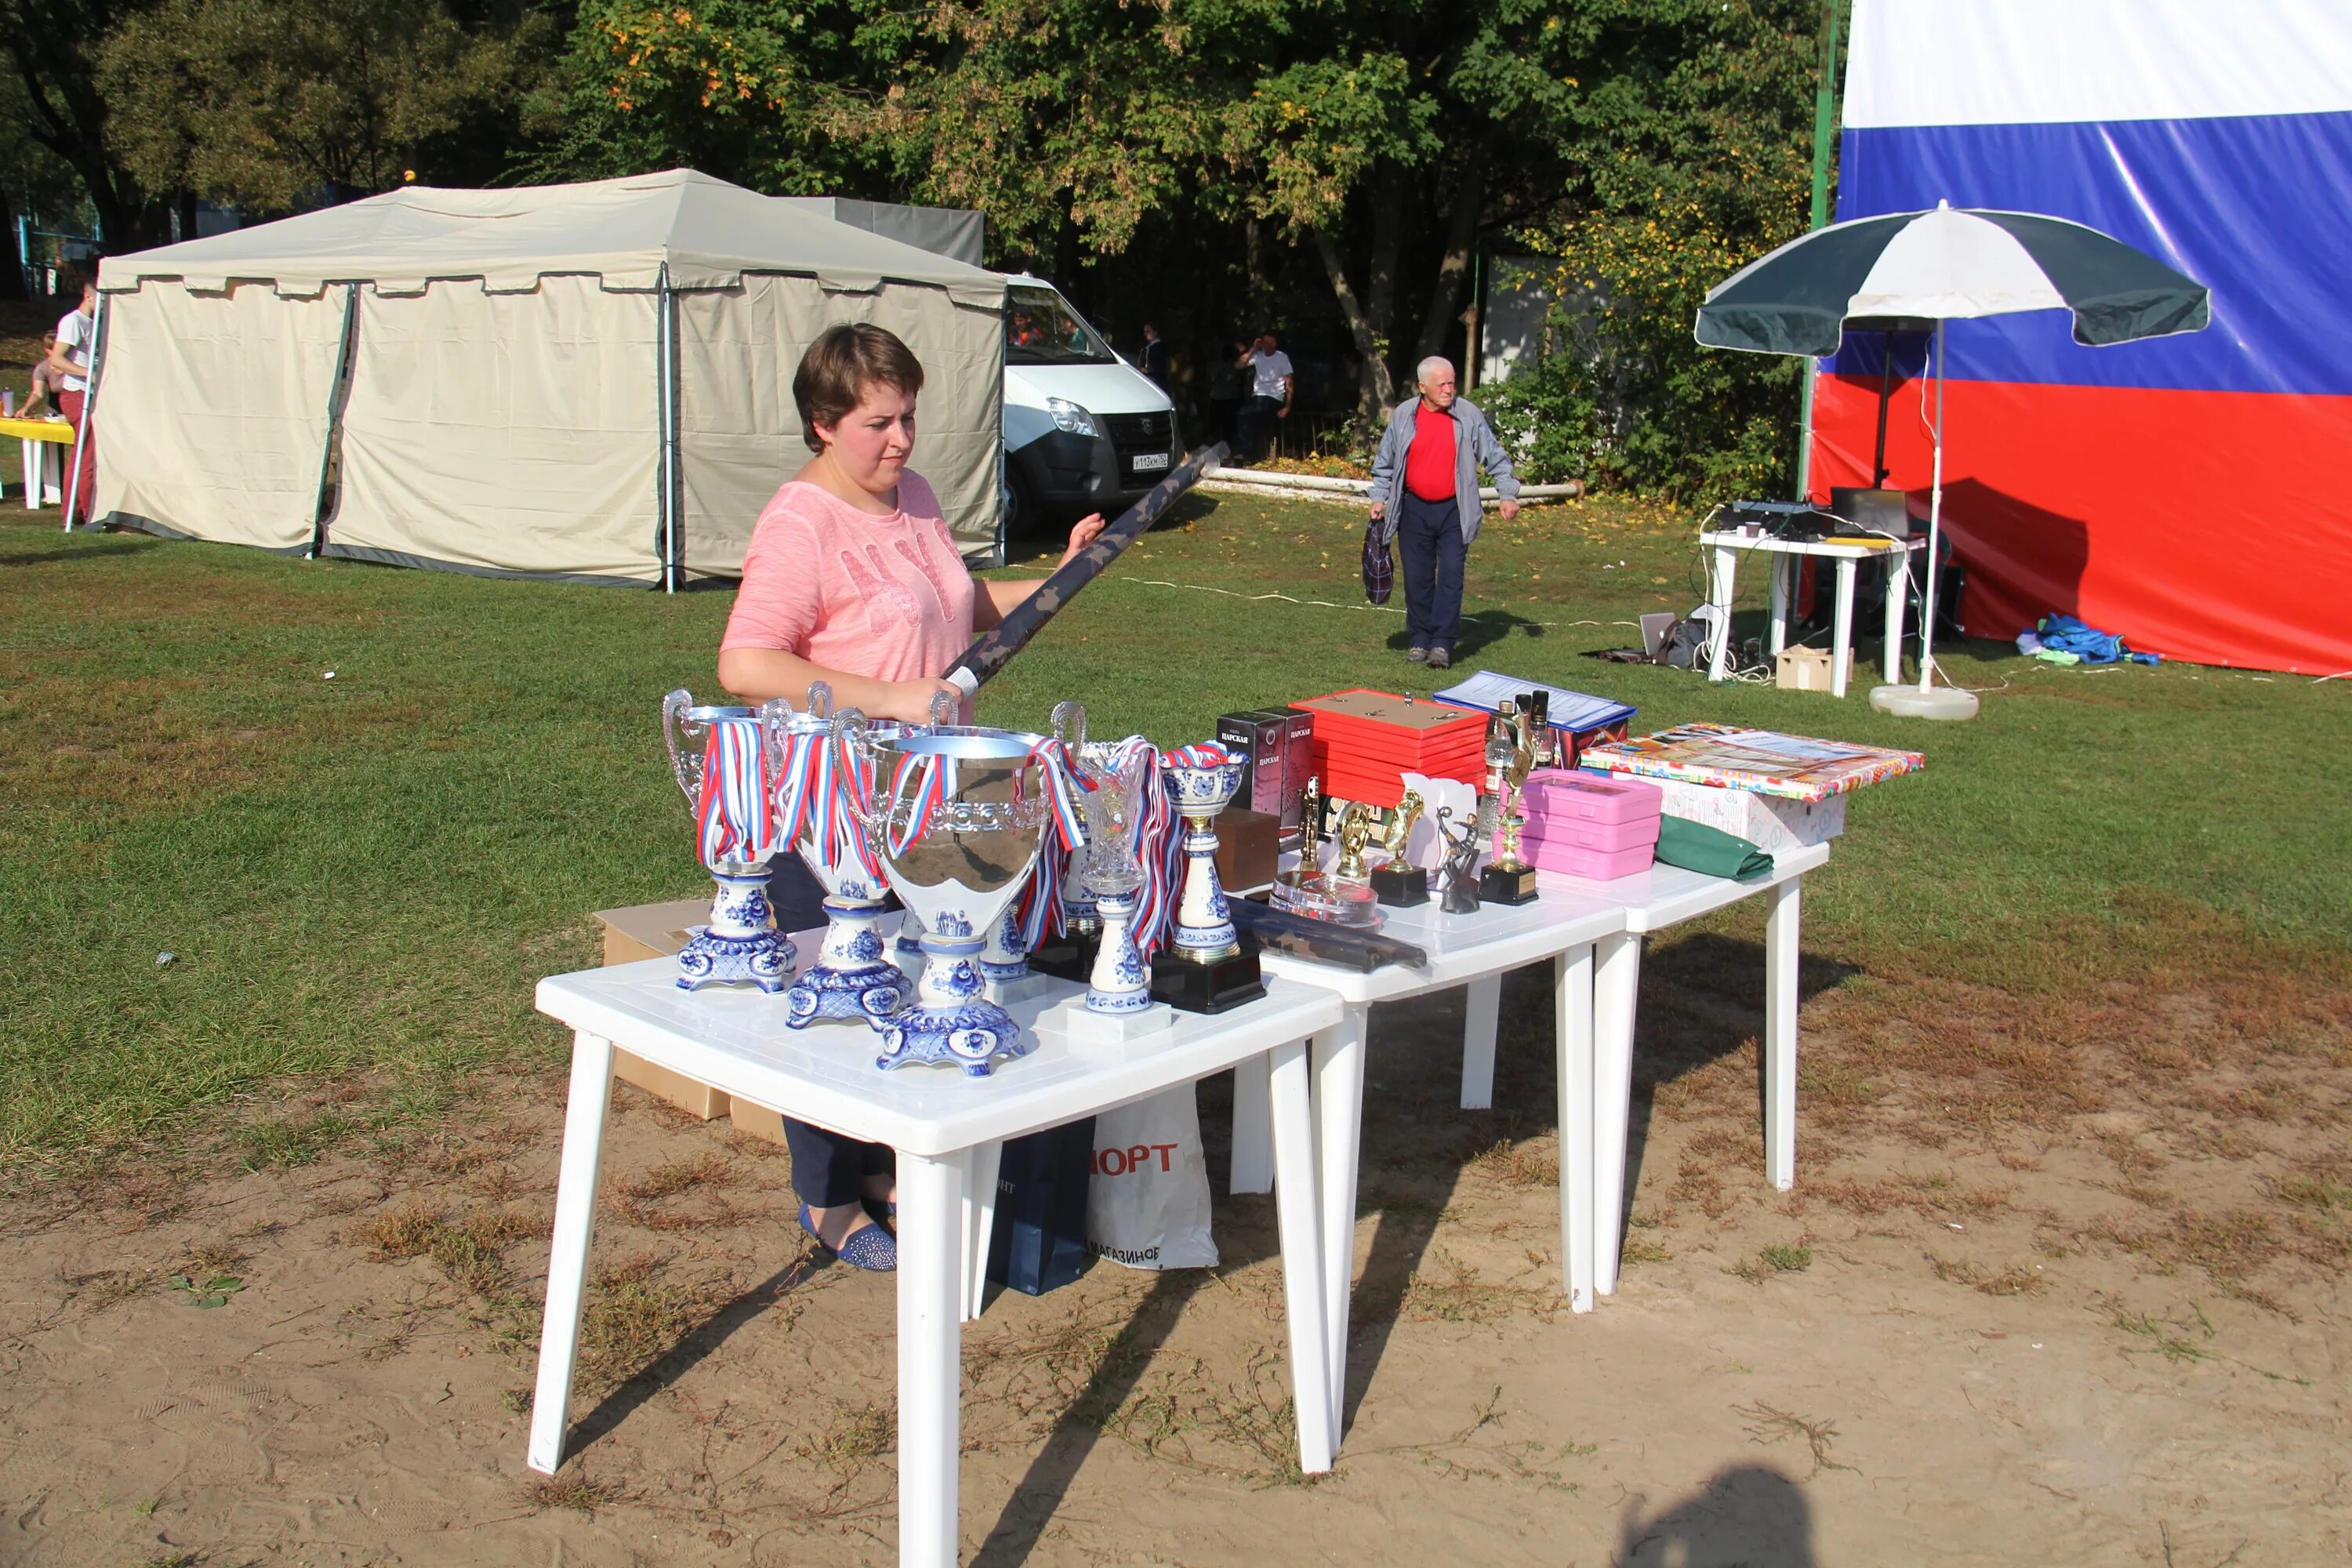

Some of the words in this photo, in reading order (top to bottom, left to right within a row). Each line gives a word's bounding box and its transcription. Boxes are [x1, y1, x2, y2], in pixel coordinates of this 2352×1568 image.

[1221, 732, 1248, 744] ЦАРСКАЯ
[1290, 728, 1310, 739] ЦАРСКАЯ
[1259, 755, 1279, 766] ЦАРСКАЯ
